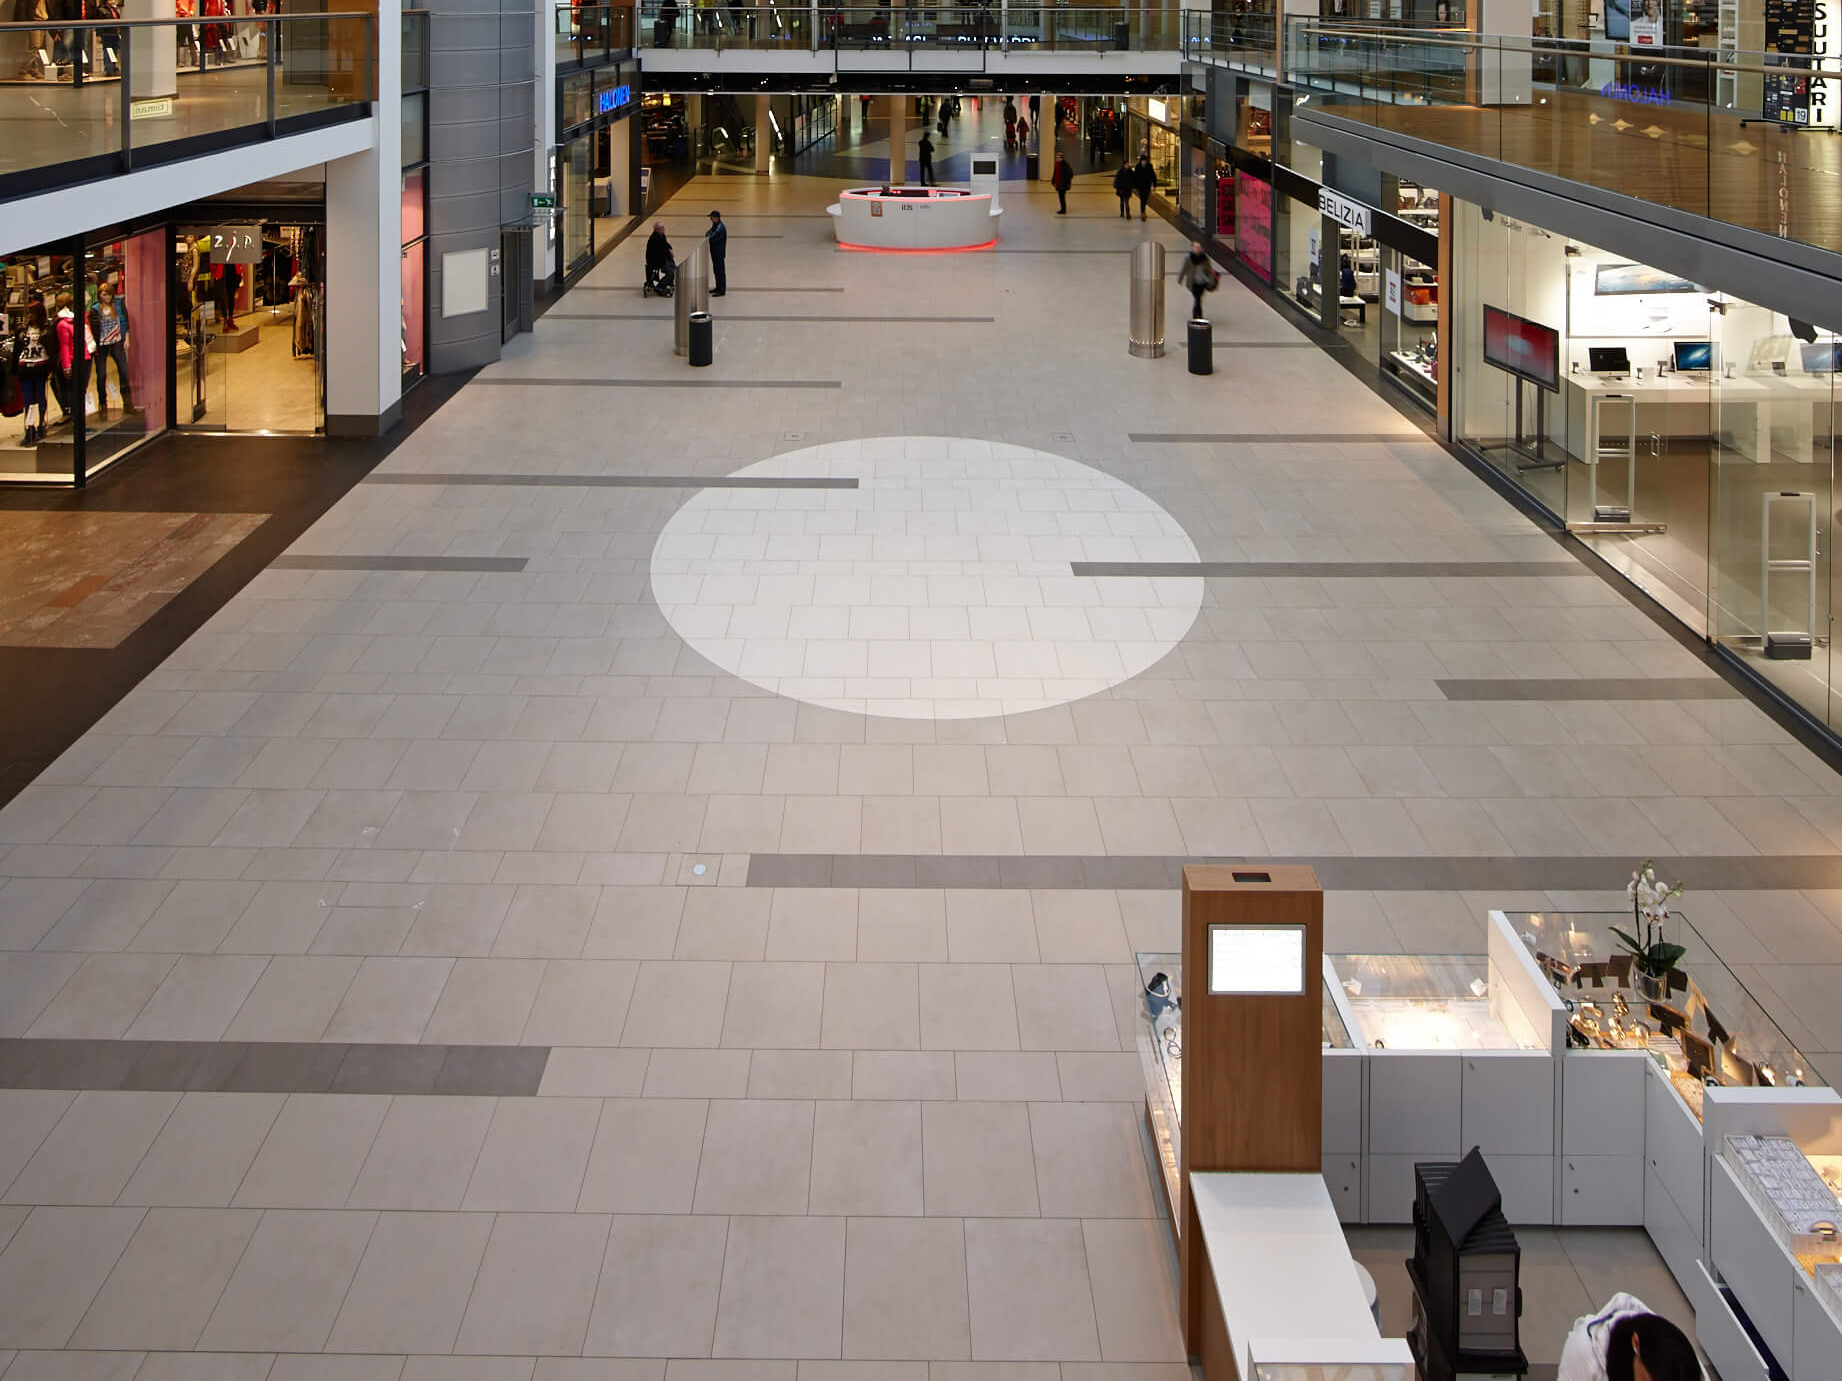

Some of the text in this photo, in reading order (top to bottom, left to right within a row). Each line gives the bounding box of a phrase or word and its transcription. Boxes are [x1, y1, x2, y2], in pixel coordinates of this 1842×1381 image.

[1811, 2, 1828, 123] SUUTARI
[599, 84, 631, 113] HALONEN
[1319, 195, 1365, 231] BELIZIA
